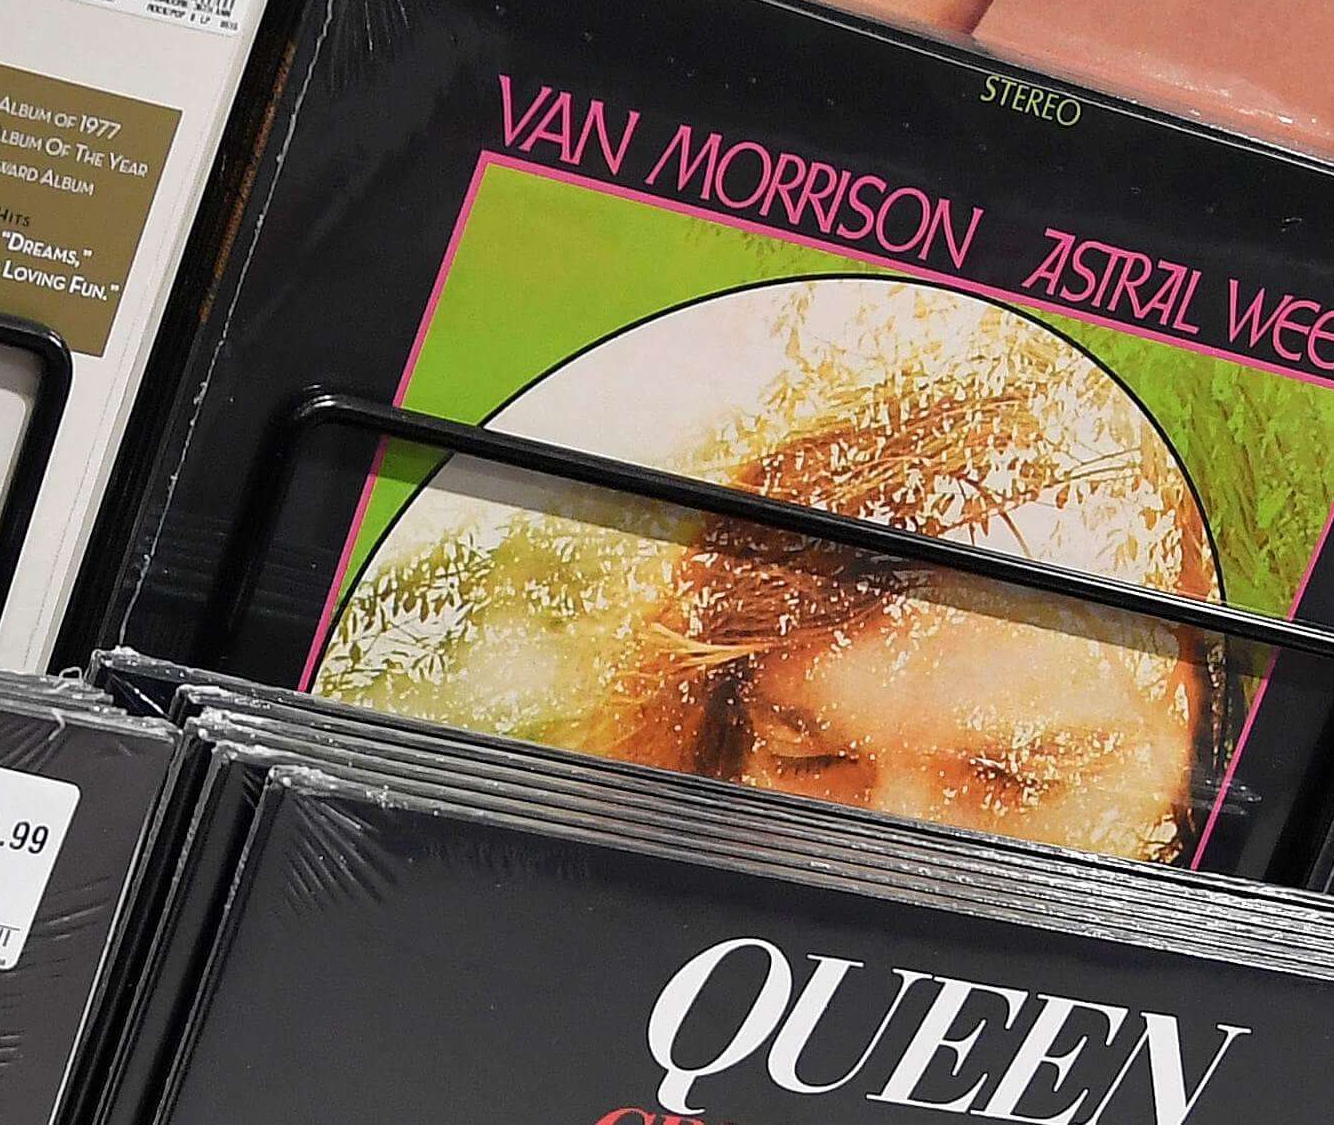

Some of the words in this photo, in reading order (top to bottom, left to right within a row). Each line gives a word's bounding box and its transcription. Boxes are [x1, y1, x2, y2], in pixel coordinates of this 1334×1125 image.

[980, 74, 1082, 127] STEREO
[54, 112, 78, 129] OF
[79, 115, 122, 140] 1977
[45, 138, 71, 158] OF
[74, 143, 105, 168] THE
[109, 152, 149, 178] YEAR
[40, 169, 95, 196] ALBUM
[498, 74, 641, 175] VAN
[645, 124, 984, 270] MORRISON
[1021, 227, 1204, 335] ASTRAL
[2, 260, 67, 291] LOVING
[647, 936, 1252, 1125] QUEEN
